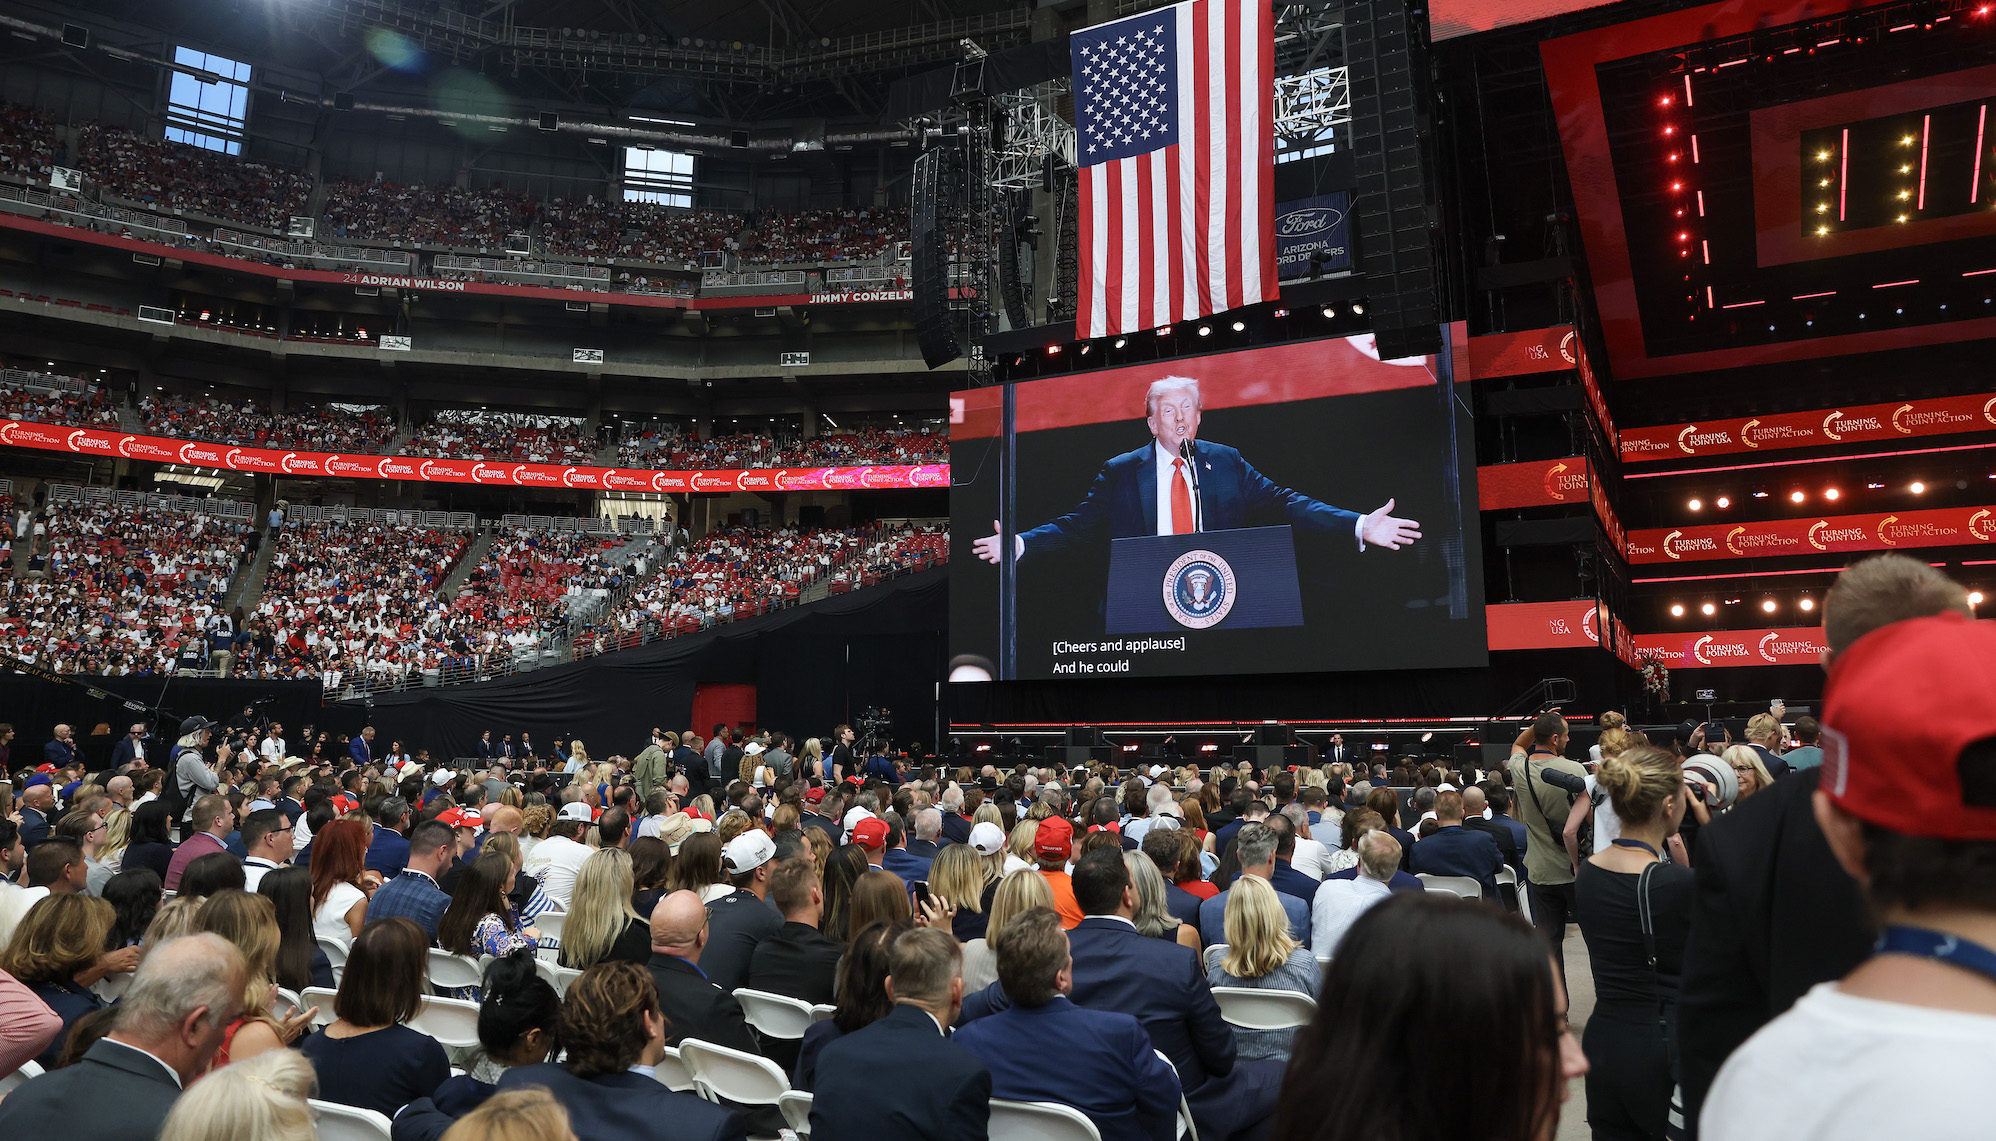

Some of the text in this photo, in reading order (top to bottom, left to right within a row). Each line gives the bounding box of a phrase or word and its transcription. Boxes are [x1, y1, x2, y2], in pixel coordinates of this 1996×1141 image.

[1282, 212, 1326, 234] Ford
[1283, 240, 1328, 254] ARIZONA
[1276, 247, 1344, 264] ORD DEERS
[343, 274, 464, 290] 24 ADRIAN WILSON
[809, 290, 914, 304] JIMMY CONZELM
[1530, 352, 1549, 360] USA
[1904, 410, 1949, 420] TURNING
[1834, 417, 1877, 426] TURNING
[1906, 414, 1973, 426] POINT ACTION
[1752, 426, 1792, 436] TURNING
[1836, 424, 1864, 432] POINT
[1689, 432, 1728, 441] TURNING
[1754, 429, 1814, 440] POINT ACTION
[34, 436, 60, 444] ACTION
[78, 437, 108, 445] TURNING
[1690, 438, 1712, 446] POINT
[1558, 474, 1585, 483] TURN
[1820, 528, 1862, 536] TURNING
[1890, 523, 1934, 532] TURNING
[1922, 528, 1958, 536] ACTION
[1674, 538, 1712, 546] TURNING
[1738, 534, 1778, 542] TURNING
[1767, 538, 1798, 546] ACTION
[1166, 554, 1198, 587] PRESIDENT
[1218, 562, 1233, 594] UNITED
[1205, 600, 1229, 624] STATES
[1552, 626, 1571, 634] USA
[1053, 637, 1185, 655] [Cheers and applause]
[1053, 660, 1129, 674] And he could
[16, 664, 40, 676] GREAT
[41, 673, 62, 684] AGAIN
